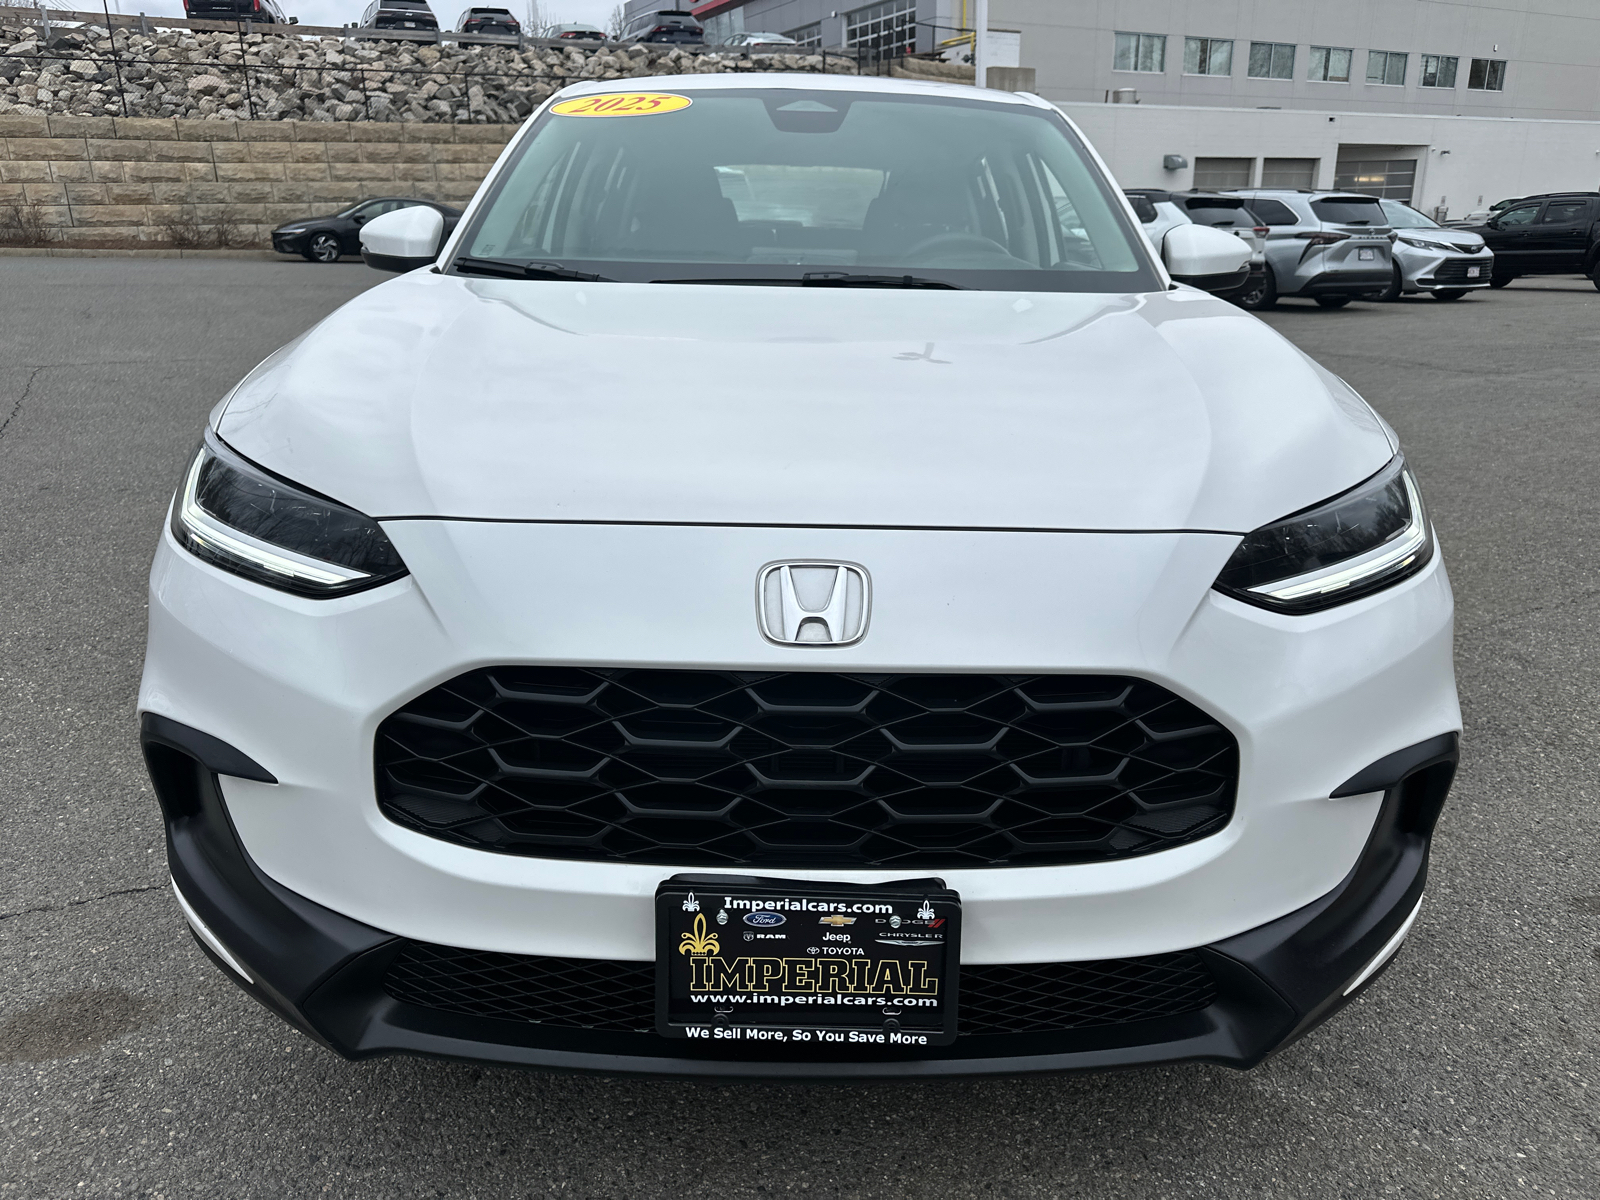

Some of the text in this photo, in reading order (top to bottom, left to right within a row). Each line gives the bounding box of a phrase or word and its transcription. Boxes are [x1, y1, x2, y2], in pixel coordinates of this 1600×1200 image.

[567, 96, 672, 113] 2025
[724, 896, 893, 914] Imperialcars.com
[752, 914, 777, 924] Ford
[822, 932, 851, 943] Jeep
[822, 946, 865, 956] TOYOTA
[690, 956, 938, 995] IMPERIAL
[690, 993, 938, 1007] www.imperialcars.com
[685, 1026, 928, 1045] We Sell More, So You Save More
